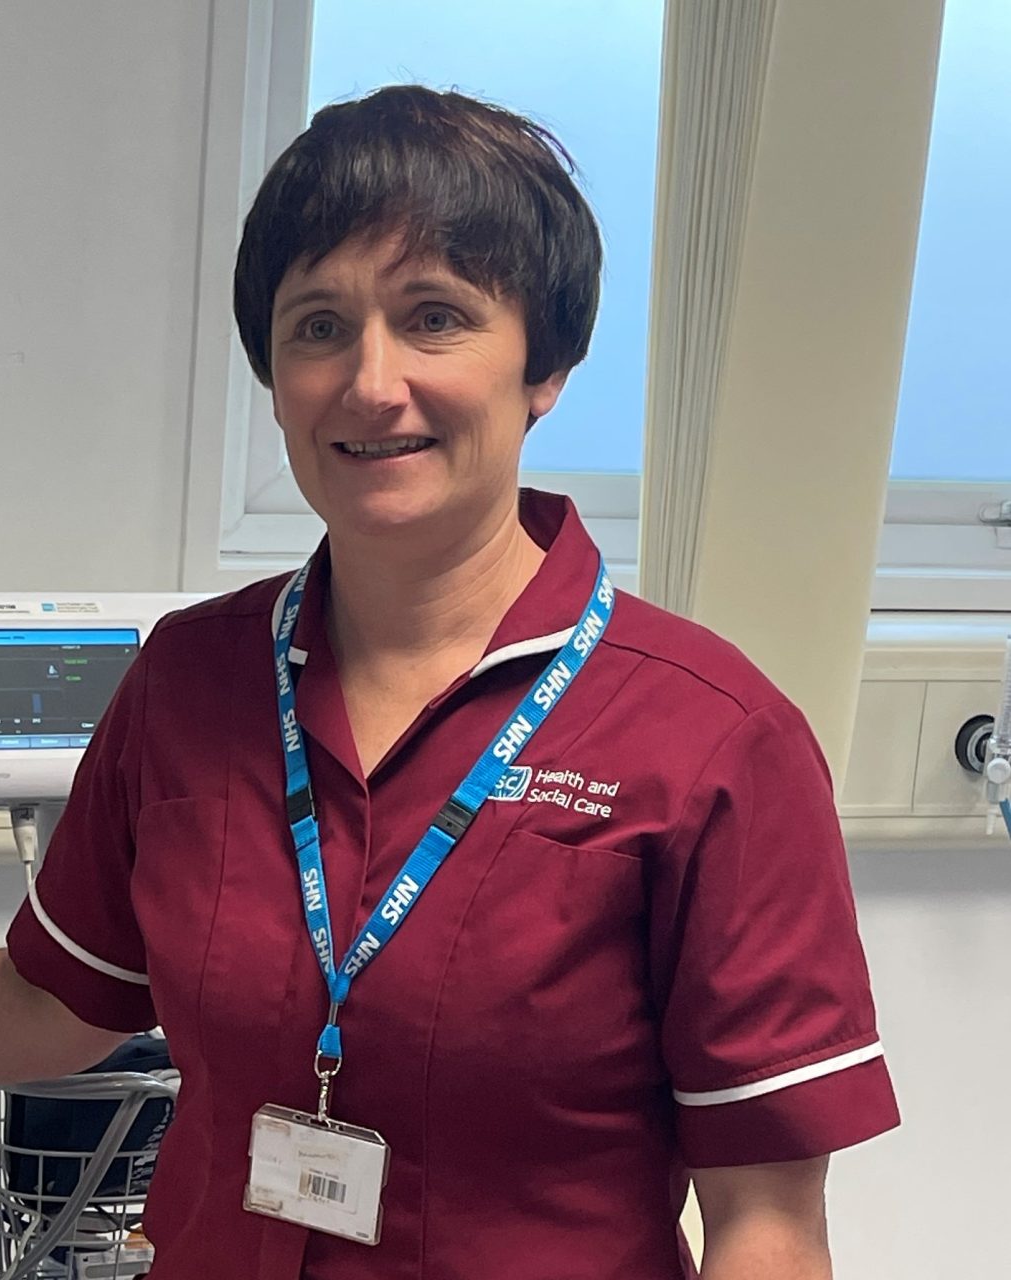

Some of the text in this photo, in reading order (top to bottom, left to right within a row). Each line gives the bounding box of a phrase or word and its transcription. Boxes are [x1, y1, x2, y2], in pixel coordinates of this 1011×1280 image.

[535, 769, 621, 797] Health and
[527, 788, 613, 818] Social Care
